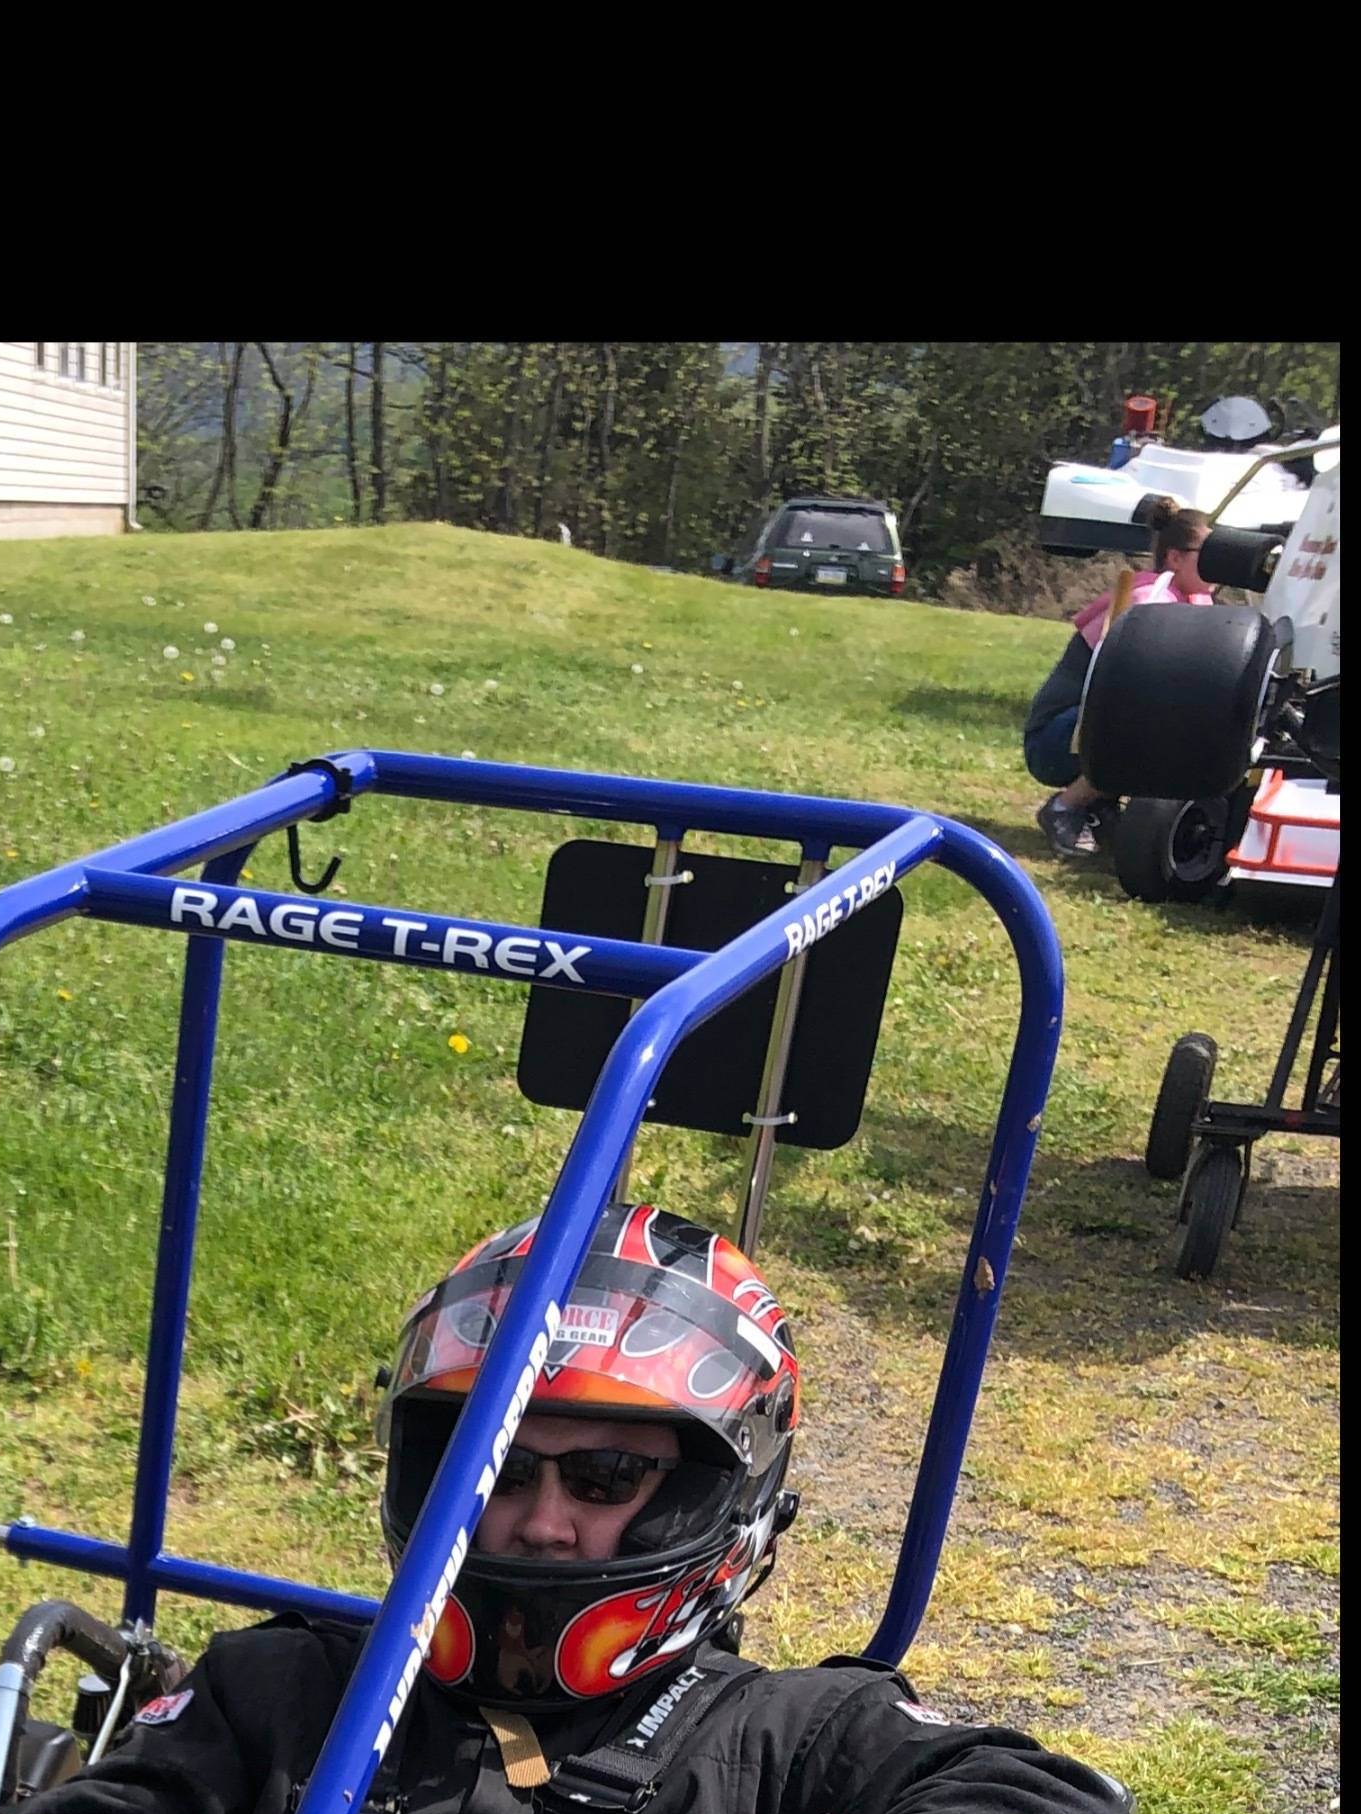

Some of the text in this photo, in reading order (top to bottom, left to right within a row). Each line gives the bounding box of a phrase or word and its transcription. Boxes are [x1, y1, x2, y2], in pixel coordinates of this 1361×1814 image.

[170, 887, 593, 985] RAGE T-REX
[783, 895, 843, 961] RAGE
[569, 1330, 609, 1344] GEAR
[636, 1665, 708, 1739] IMPACT
